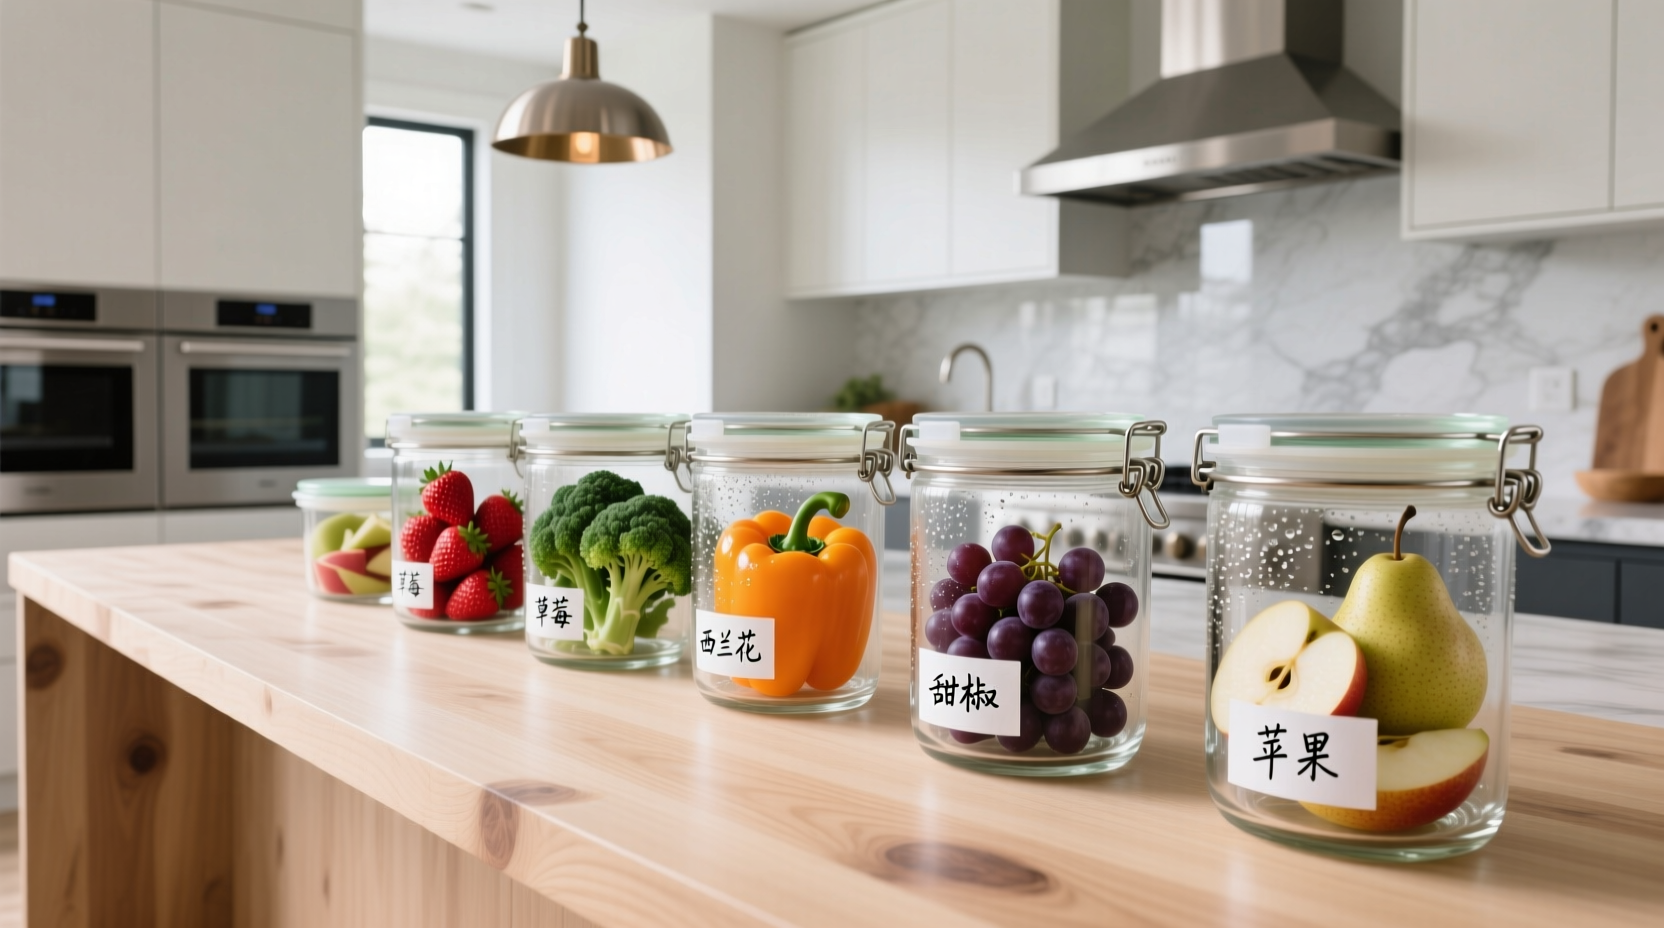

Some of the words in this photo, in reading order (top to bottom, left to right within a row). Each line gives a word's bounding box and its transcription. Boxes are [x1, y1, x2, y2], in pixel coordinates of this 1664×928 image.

[535, 595, 573, 628] 草莓
[700, 629, 762, 663] 西兰花
[929, 673, 999, 713] 甜椒
[1252, 723, 1339, 782] 苹果
